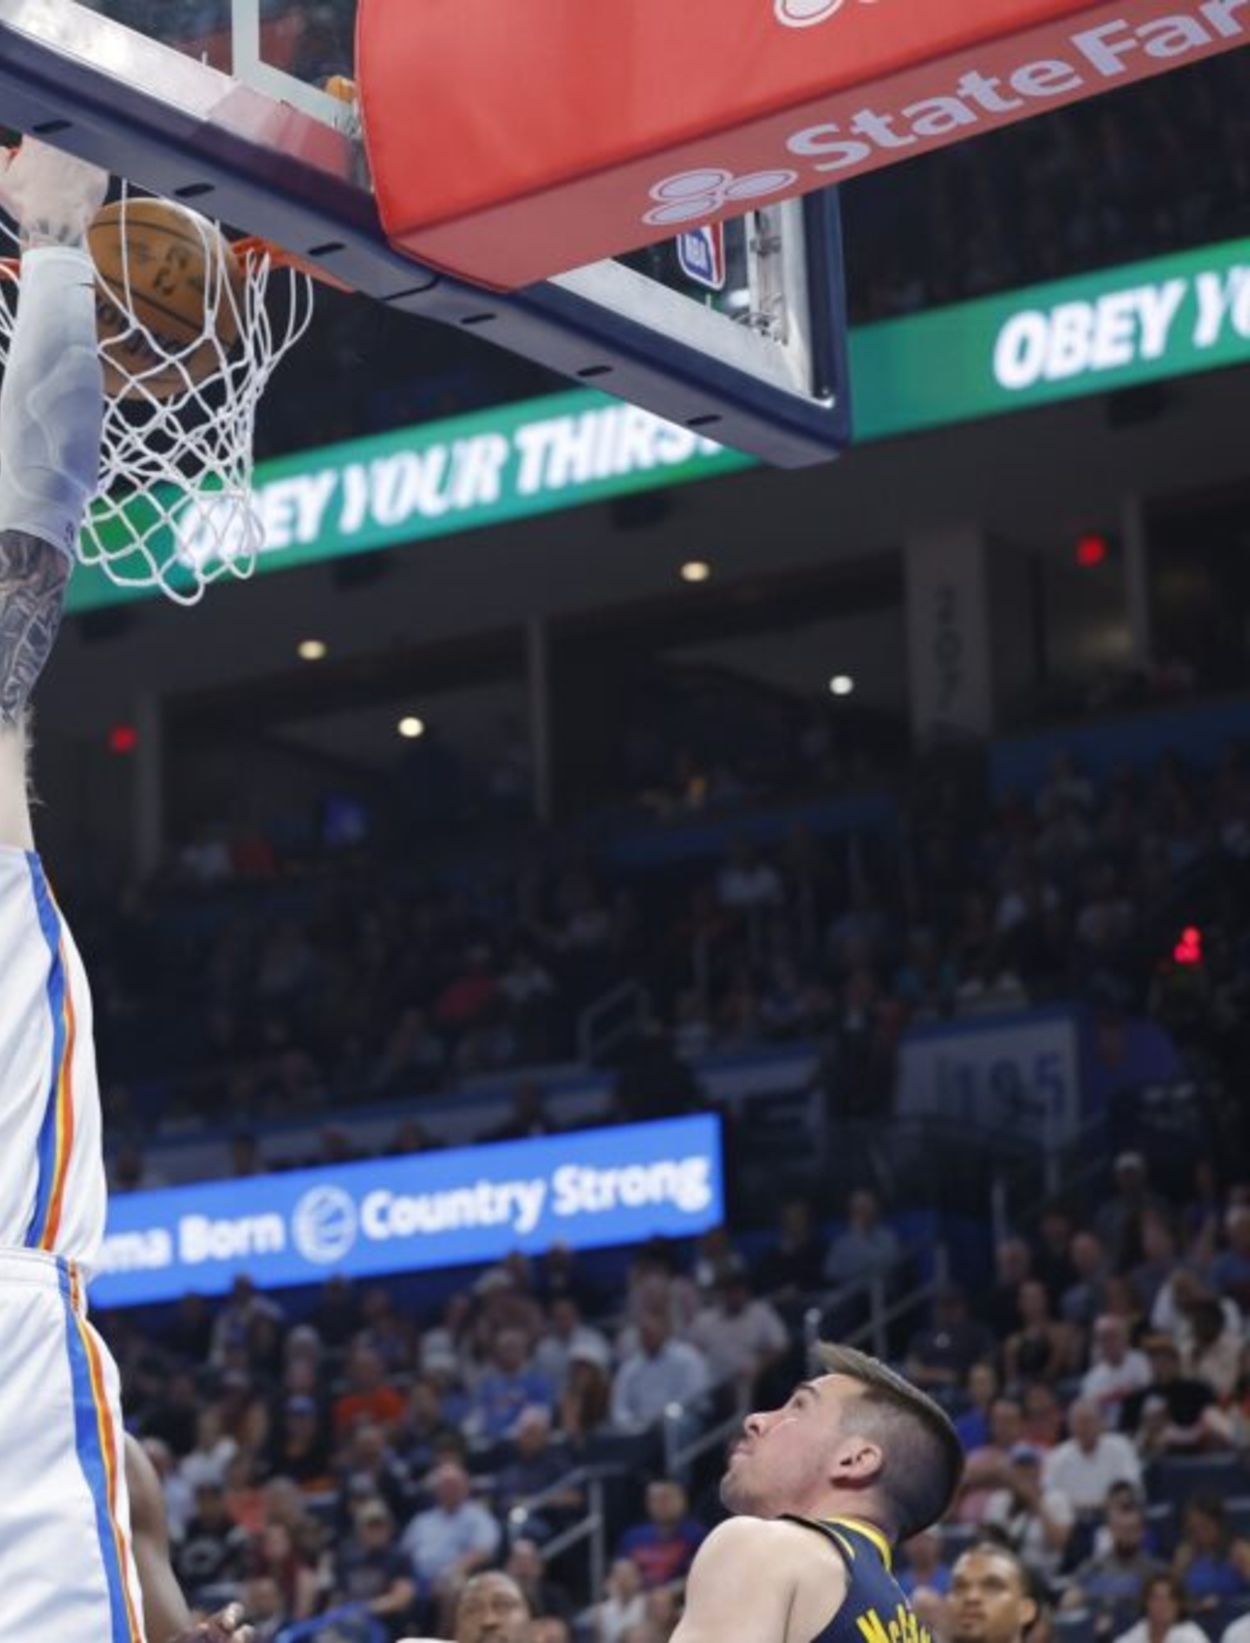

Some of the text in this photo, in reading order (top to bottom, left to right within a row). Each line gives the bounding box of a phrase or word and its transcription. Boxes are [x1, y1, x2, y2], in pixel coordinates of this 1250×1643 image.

[786, 60, 1084, 171] State
[993, 277, 1187, 391] OBEY
[514, 402, 726, 495] THIRS
[178, 1212, 287, 1266] Born
[360, 1177, 547, 1241] Country
[552, 1156, 713, 1216] Strong
